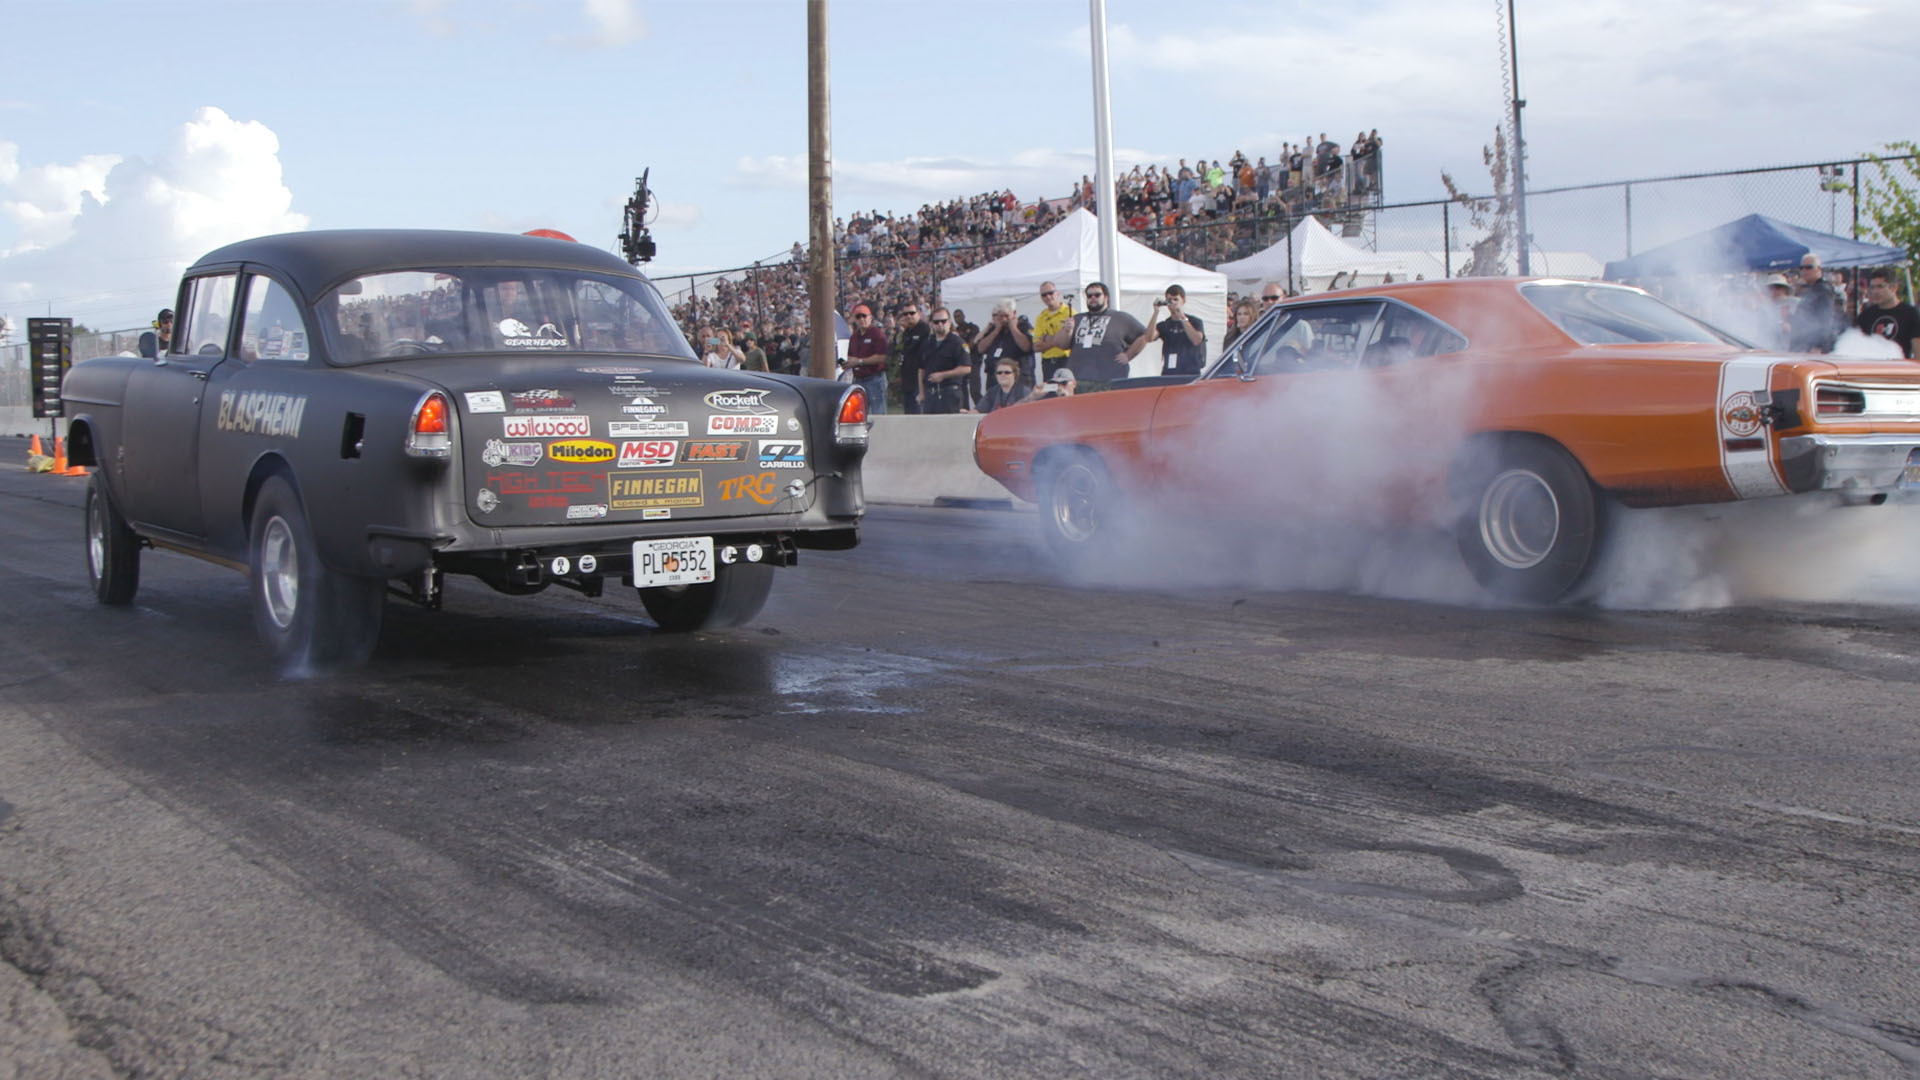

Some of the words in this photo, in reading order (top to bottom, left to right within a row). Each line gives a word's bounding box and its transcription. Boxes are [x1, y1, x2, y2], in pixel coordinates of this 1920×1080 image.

[711, 395, 760, 406] Rockett
[218, 391, 307, 438] BLASPHEMI
[623, 405, 666, 414] FINNEGAN'S
[506, 416, 589, 437] wilwood
[711, 417, 762, 430] COMP
[497, 444, 541, 457] VIKING
[551, 445, 613, 458] Milodon
[622, 441, 675, 459] MSD
[689, 444, 741, 458] FAST
[759, 461, 805, 469] CARRILLO
[487, 470, 538, 491] HIGH
[545, 469, 607, 490] TECH
[613, 477, 699, 496] FINNEGAN
[718, 472, 778, 505] TRG
[652, 541, 695, 551] GEORGIA
[642, 549, 707, 575] PLP5552
